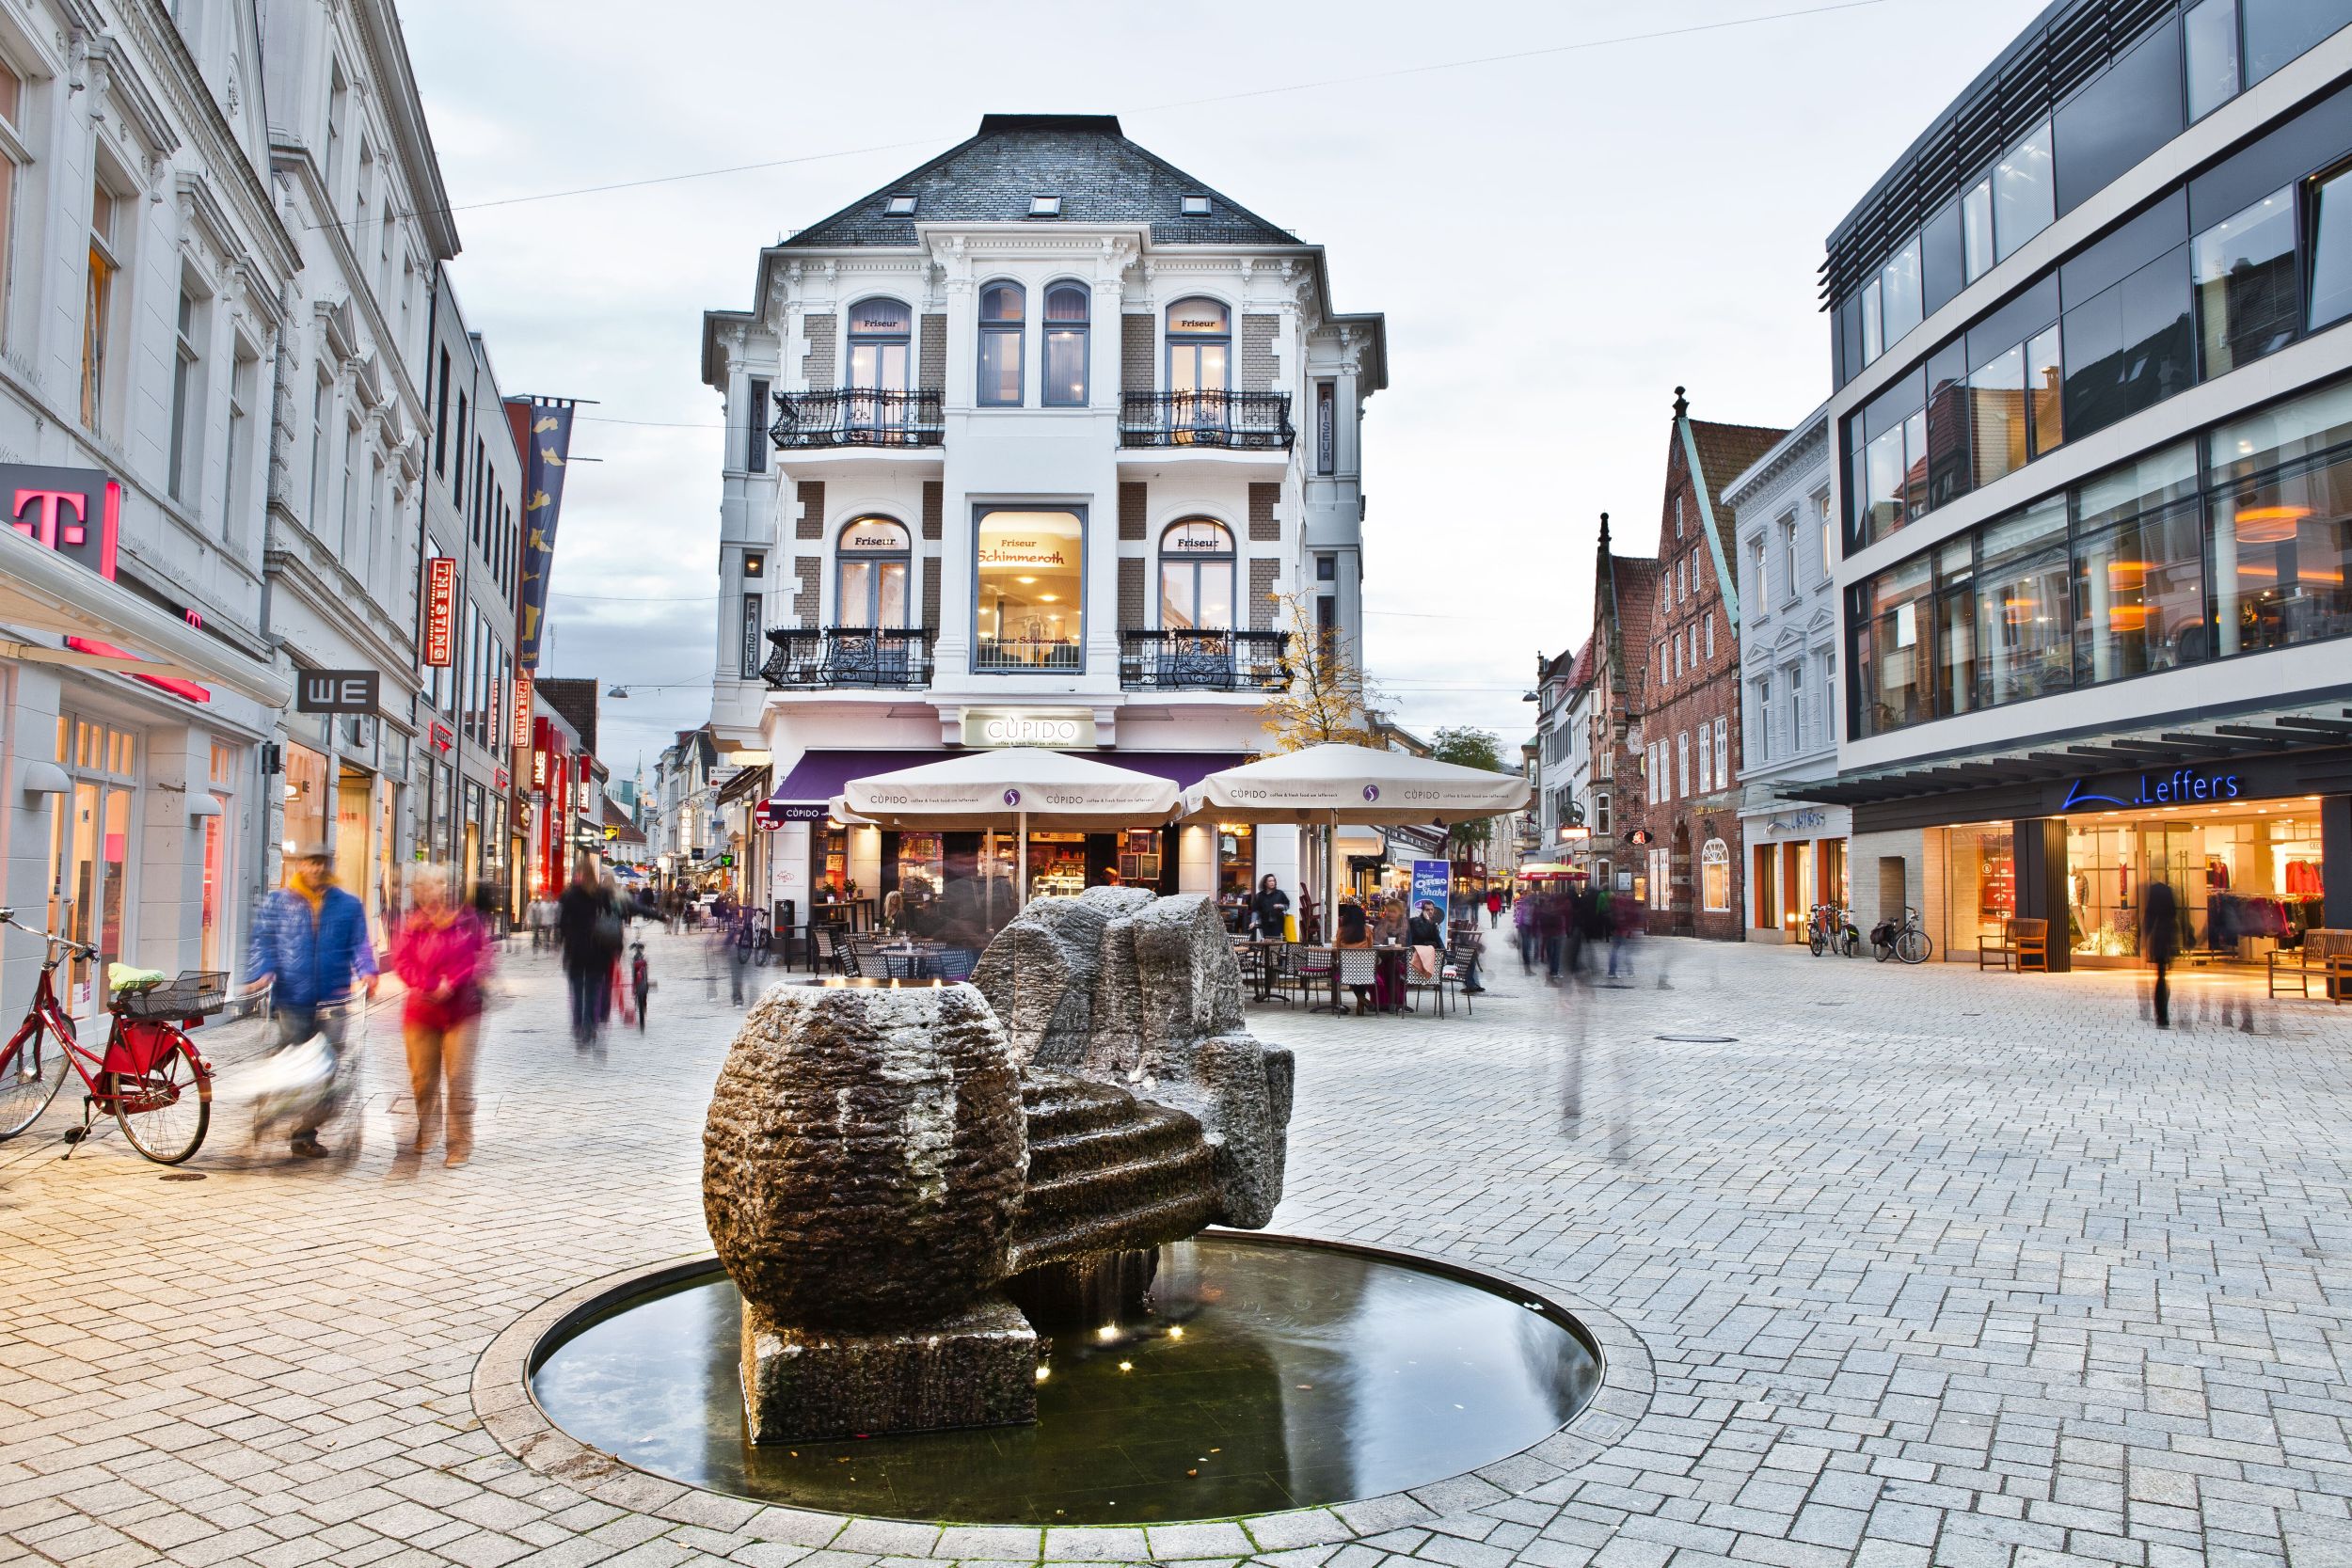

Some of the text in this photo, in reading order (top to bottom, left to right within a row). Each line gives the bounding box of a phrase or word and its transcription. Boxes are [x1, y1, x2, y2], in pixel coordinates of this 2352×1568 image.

[1322, 391, 1330, 462] FRISEUR
[855, 537, 896, 546] Friseur
[1001, 539, 1037, 547] Friseur
[1178, 538, 1219, 547] Friseur
[978, 549, 1064, 564] Schimmeroth
[434, 564, 449, 659] THE STING
[747, 602, 755, 674] FRISEUR
[309, 678, 368, 704] WE
[988, 716, 1074, 738] CÙPIDO
[534, 751, 546, 786] ESPRIT
[2141, 768, 2238, 803] Leffers
[580, 783, 590, 809] ESPRIT
[870, 793, 907, 804] CÙPIDO
[1046, 793, 1083, 804] CÙPIDO
[1231, 788, 1266, 799] CÙPIDO
[1405, 790, 1440, 800] CÙPIDO
[787, 808, 818, 817] CÙPIDO
[1415, 879, 1447, 889] OREO
[1421, 887, 1447, 897] Shake
